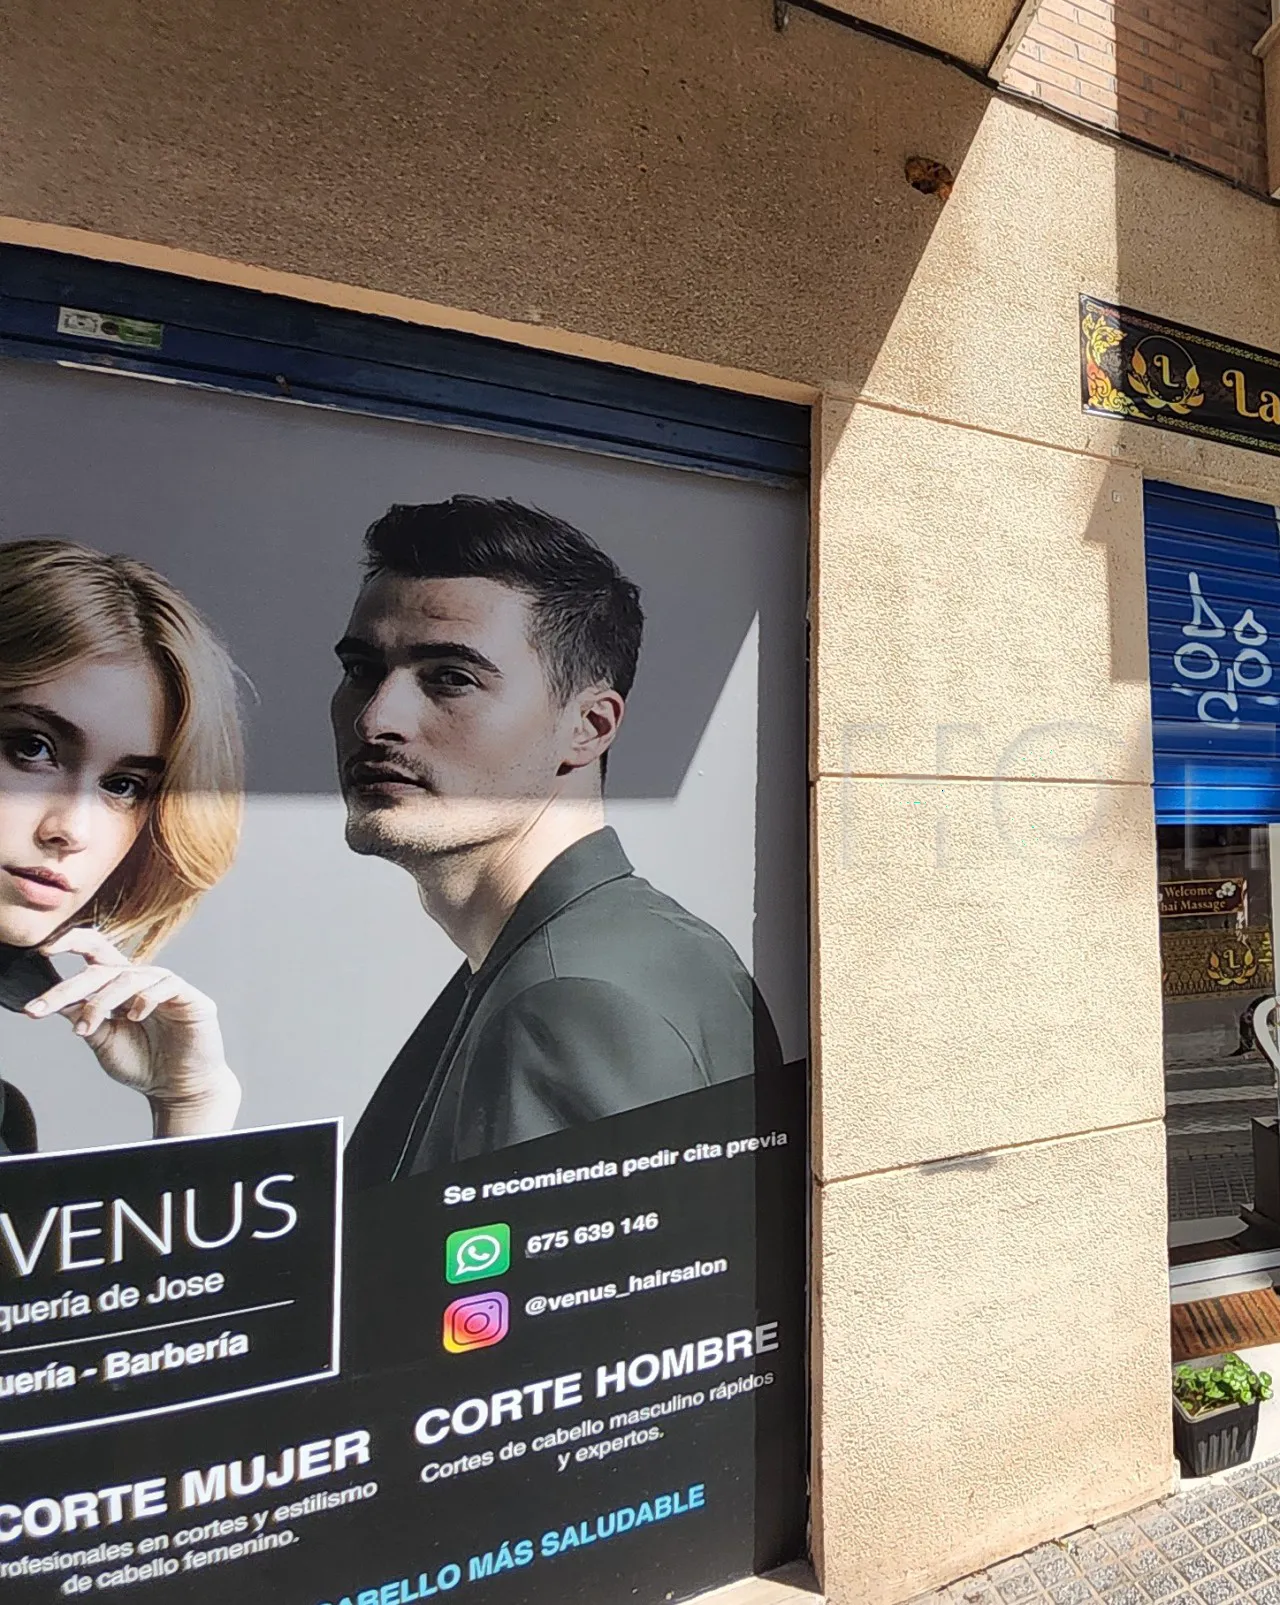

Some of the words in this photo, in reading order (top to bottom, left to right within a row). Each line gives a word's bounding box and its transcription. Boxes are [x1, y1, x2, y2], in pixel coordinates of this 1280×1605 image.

[1161, 901, 1178, 912] hai
[1180, 900, 1226, 913] Massage
[1164, 885, 1214, 898] Welcome
[444, 1185, 476, 1204] Se
[482, 1159, 618, 1199] recomienda
[622, 1150, 679, 1178] pedir
[683, 1142, 721, 1163] cita
[726, 1131, 788, 1160] previa
[0, 1174, 298, 1277] VENUS
[526, 1230, 569, 1254] 675
[574, 1221, 615, 1244] 639
[621, 1212, 660, 1235] 146
[100, 1284, 140, 1313] de
[146, 1272, 225, 1305] Jose
[525, 1257, 728, 1316] @venus_hairsalon
[102, 1331, 249, 1381] Barbería
[415, 1372, 583, 1446] CORTE
[595, 1321, 779, 1399] HOMBRE
[420, 1447, 494, 1484] Cortes
[499, 1438, 527, 1460] de
[531, 1419, 605, 1452] cabello
[609, 1390, 705, 1431] masculino
[709, 1370, 774, 1402] rápidos
[556, 1450, 571, 1472] y
[575, 1426, 665, 1463] expertos.
[0, 1477, 167, 1543] CORTE
[180, 1430, 372, 1510] MUJER
[138, 1531, 169, 1552] en
[173, 1514, 250, 1548] cortes
[251, 1509, 269, 1533] y
[273, 1481, 379, 1523] estilismo
[61, 1573, 93, 1596] de
[96, 1552, 180, 1589] cabello
[182, 1530, 301, 1572] femenino.
[470, 1541, 534, 1582] MÁS
[541, 1484, 706, 1558] SALUDABLE
